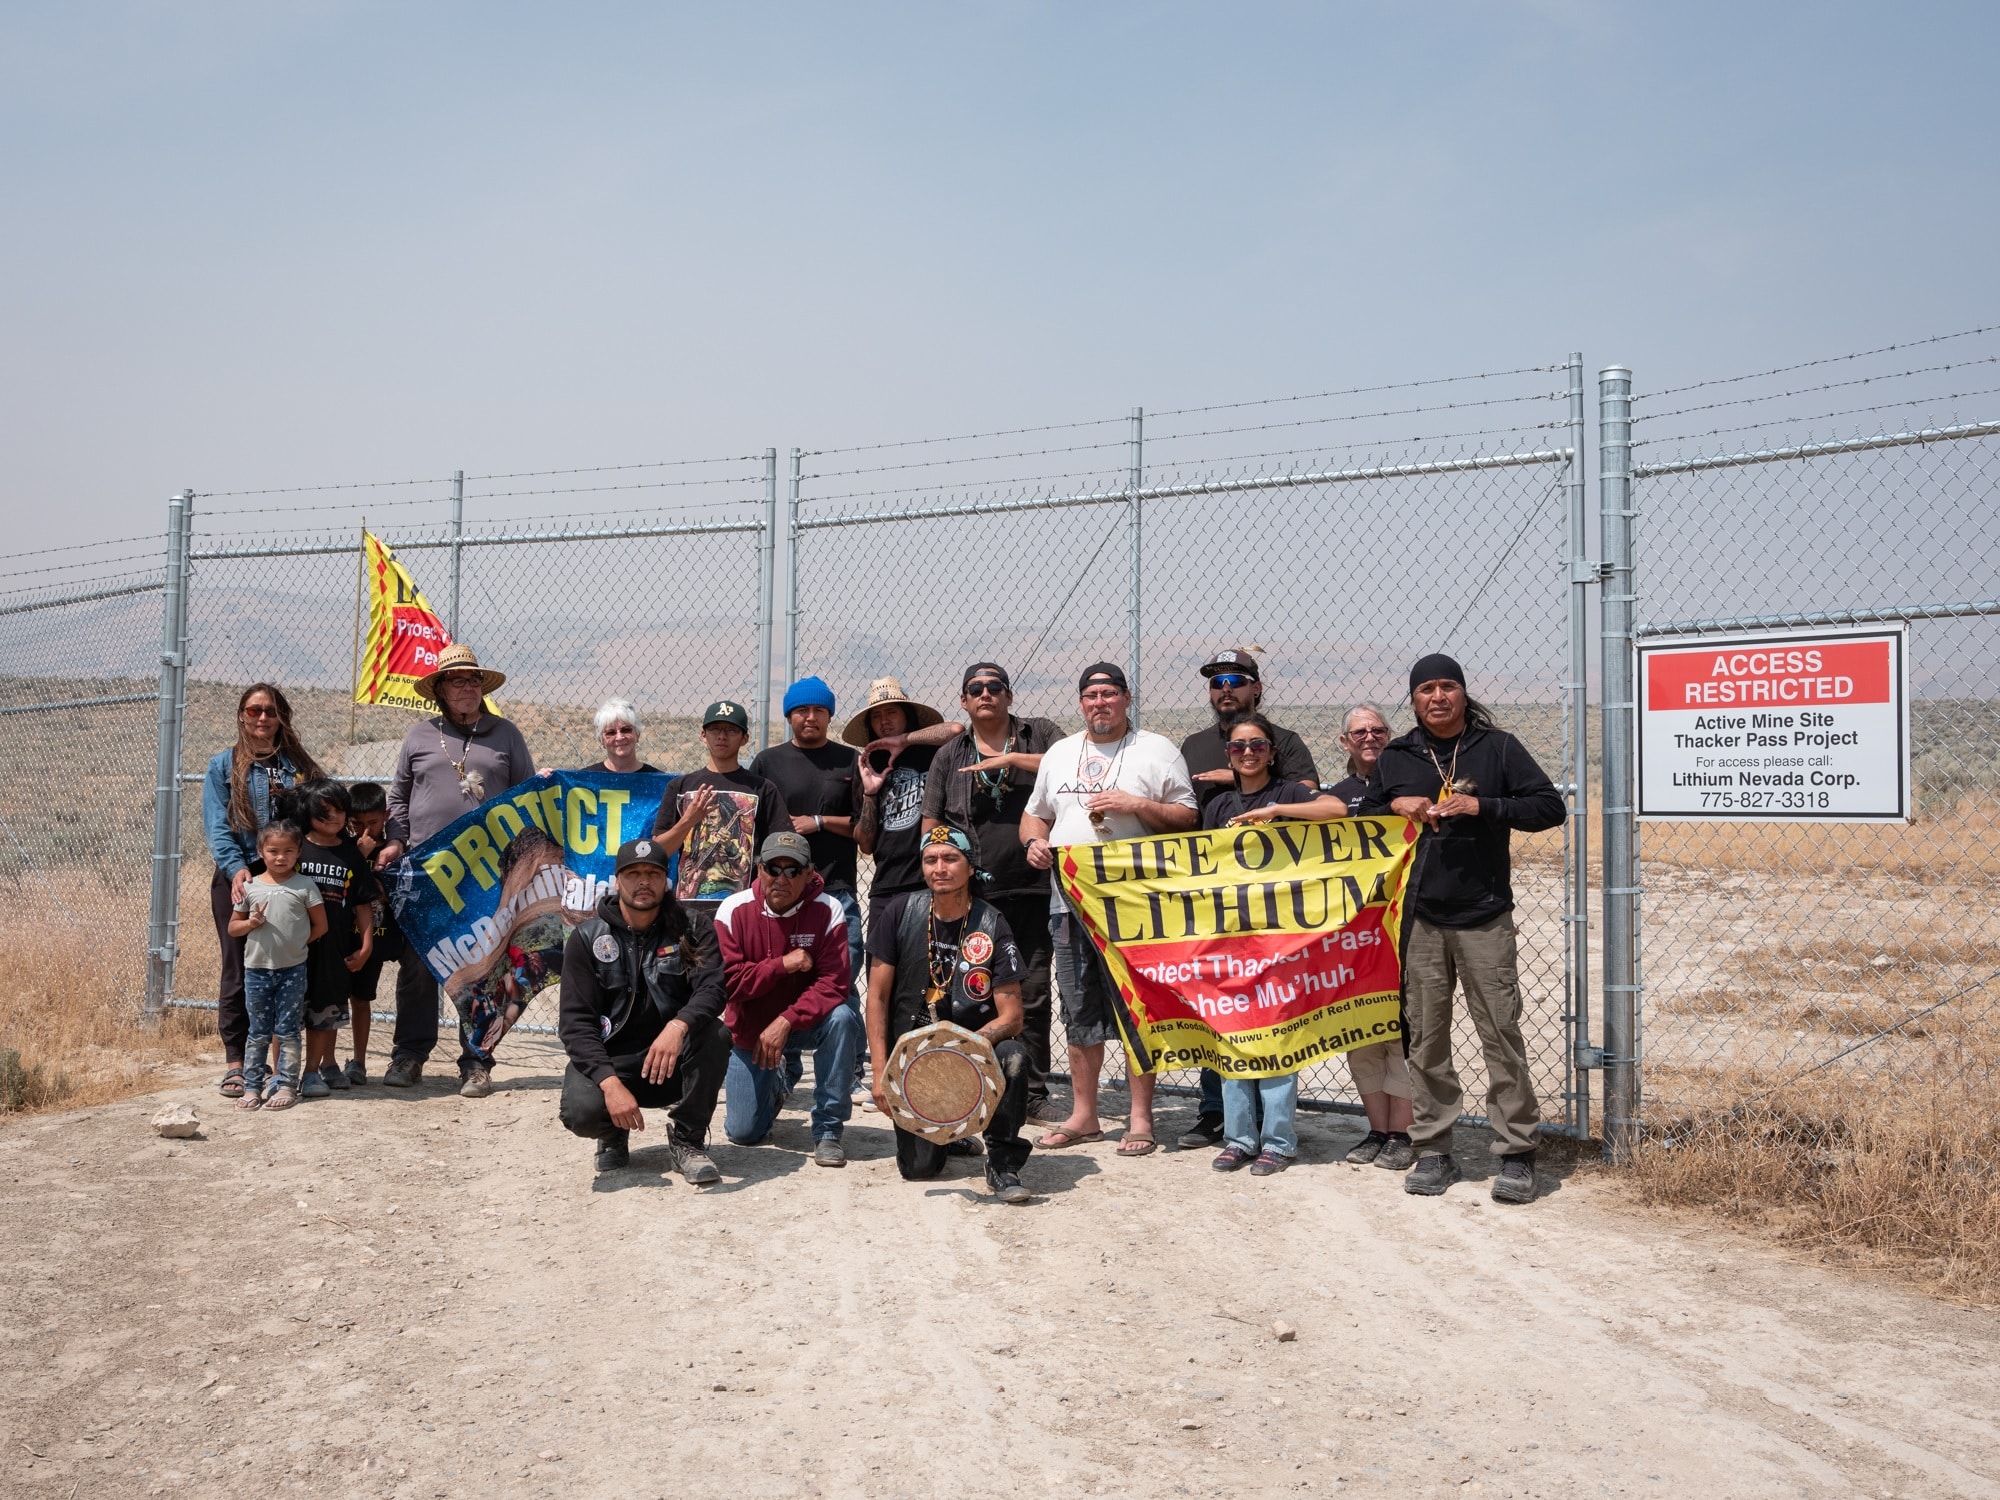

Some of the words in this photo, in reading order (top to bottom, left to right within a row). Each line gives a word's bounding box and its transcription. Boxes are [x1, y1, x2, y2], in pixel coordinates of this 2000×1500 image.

[1711, 650, 1823, 677] ACCESS
[1685, 676, 1853, 704] RESTRICTED
[1694, 715, 1746, 730] Active
[1752, 713, 1794, 729] Mine
[1799, 712, 1834, 728] Site
[1674, 733, 1740, 748] Thacker
[1746, 732, 1788, 747] Pass
[1794, 730, 1858, 749] Project
[1696, 756, 1714, 768] For
[1718, 758, 1760, 768] access
[1763, 756, 1804, 769] please
[1808, 755, 1833, 767] call:
[1672, 772, 1733, 787] Lithium
[1739, 771, 1804, 787] Nevada
[1810, 771, 1860, 789] Corp.
[1700, 791, 1829, 809] 775-827-3318
[422, 784, 630, 914] PROTECT
[1091, 833, 1219, 885] LIFE
[1233, 818, 1395, 871] OVER
[301, 862, 348, 879] PROTECT
[1097, 870, 1391, 943] LITHIUM
[1150, 1023, 1174, 1034] Atsa
[1229, 1033, 1263, 1045] Nuwu
[1271, 1016, 1310, 1038] People
[1312, 1011, 1324, 1022] of
[1327, 1001, 1351, 1016] Red
[1353, 992, 1400, 1008] Mounta
